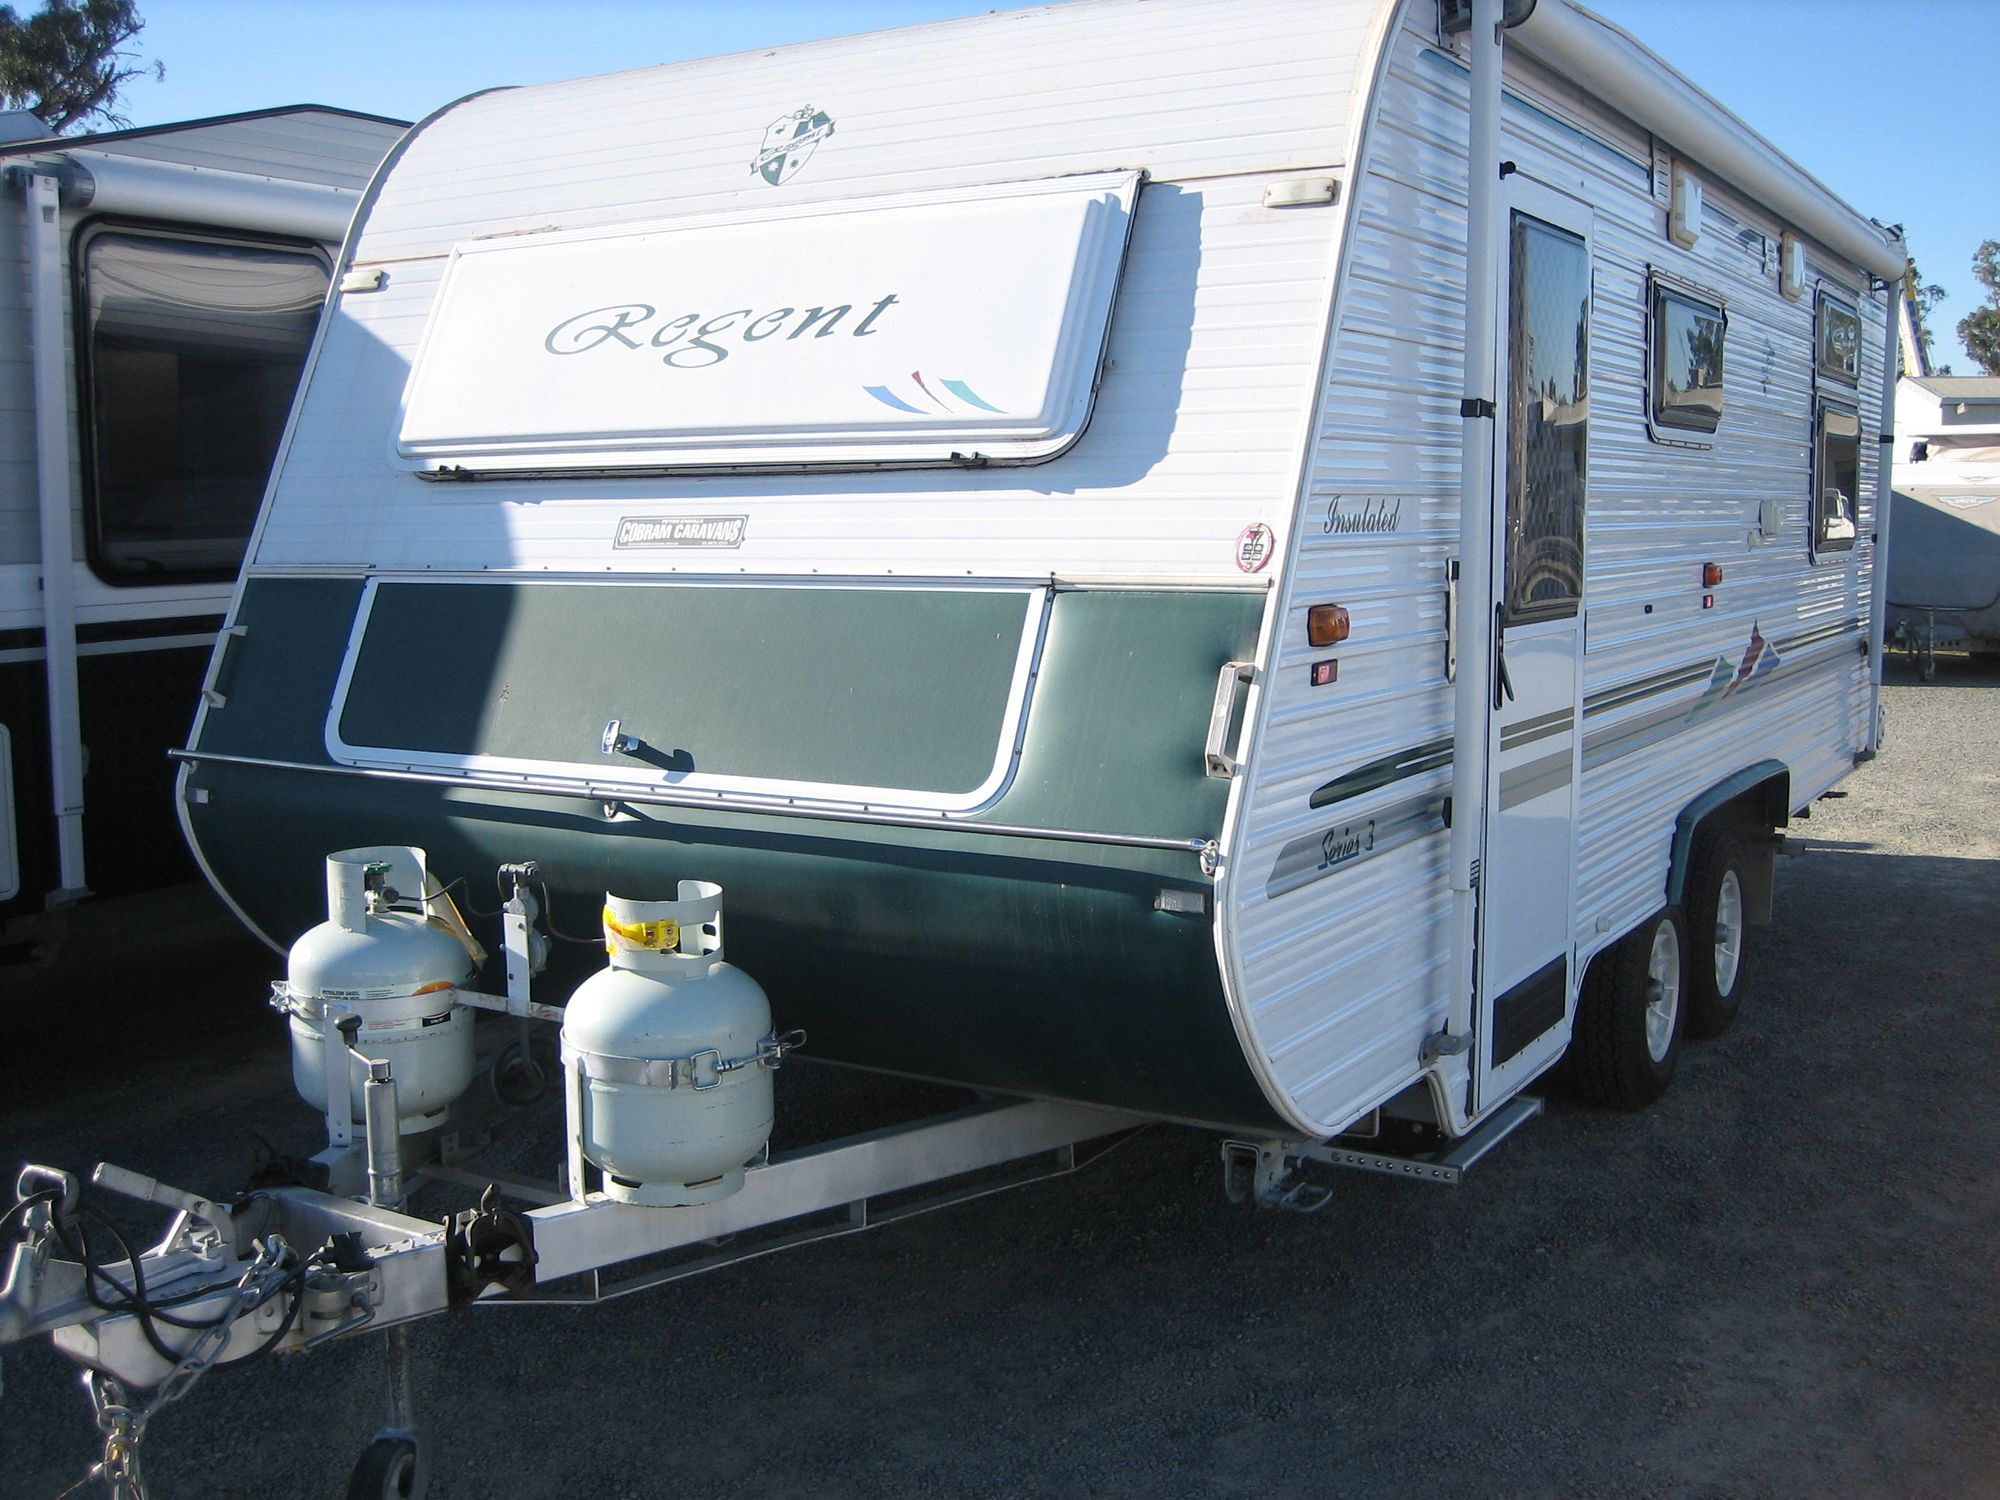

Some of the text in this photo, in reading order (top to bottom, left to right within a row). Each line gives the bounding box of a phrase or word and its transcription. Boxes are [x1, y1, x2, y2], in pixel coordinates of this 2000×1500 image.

[545, 294, 899, 368] Regent
[620, 520, 741, 542] COBRAM CARAVANS
[1324, 494, 1401, 533] Insulated
[1318, 819, 1375, 870] Series 3
